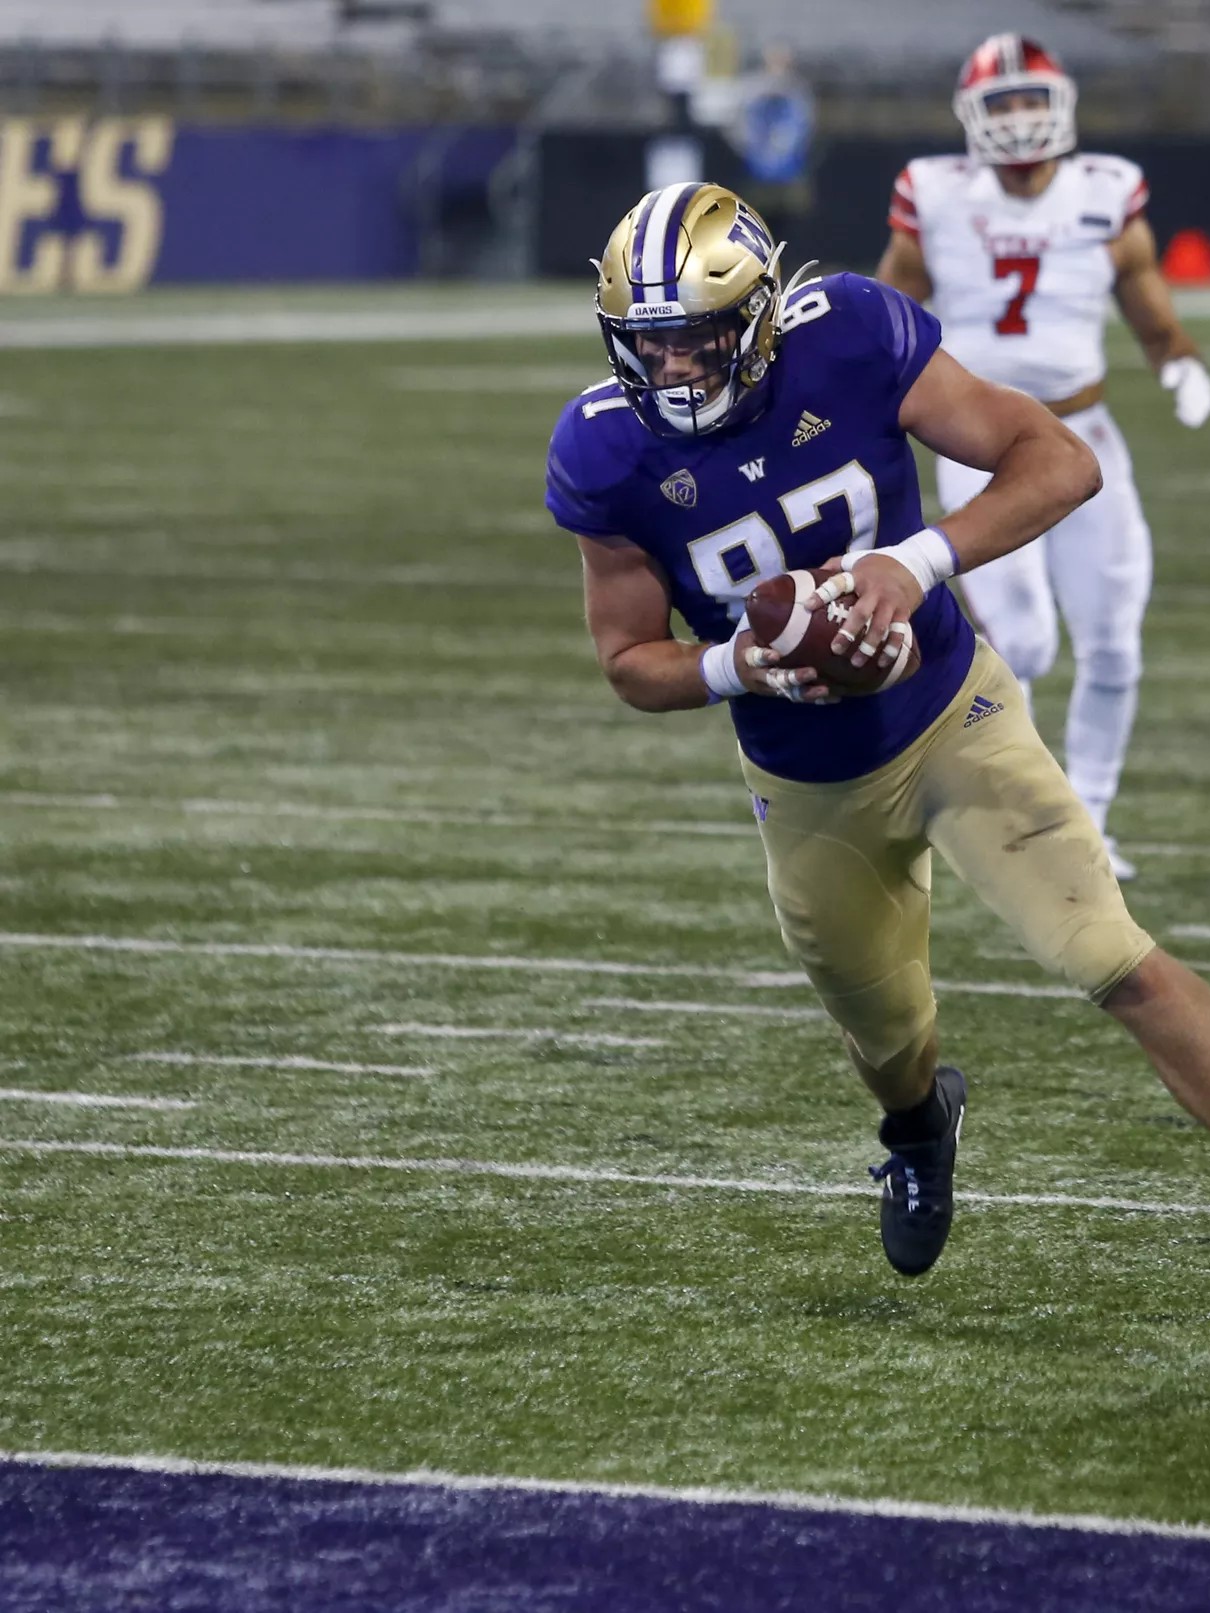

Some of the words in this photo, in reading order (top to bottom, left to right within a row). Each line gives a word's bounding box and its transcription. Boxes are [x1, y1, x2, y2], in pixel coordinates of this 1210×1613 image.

[993, 256, 1041, 336] 7
[635, 306, 673, 316] DAWGS
[792, 419, 832, 447] adidas
[738, 456, 765, 482] W
[686, 458, 879, 622] 87
[963, 702, 1004, 728] adidas
